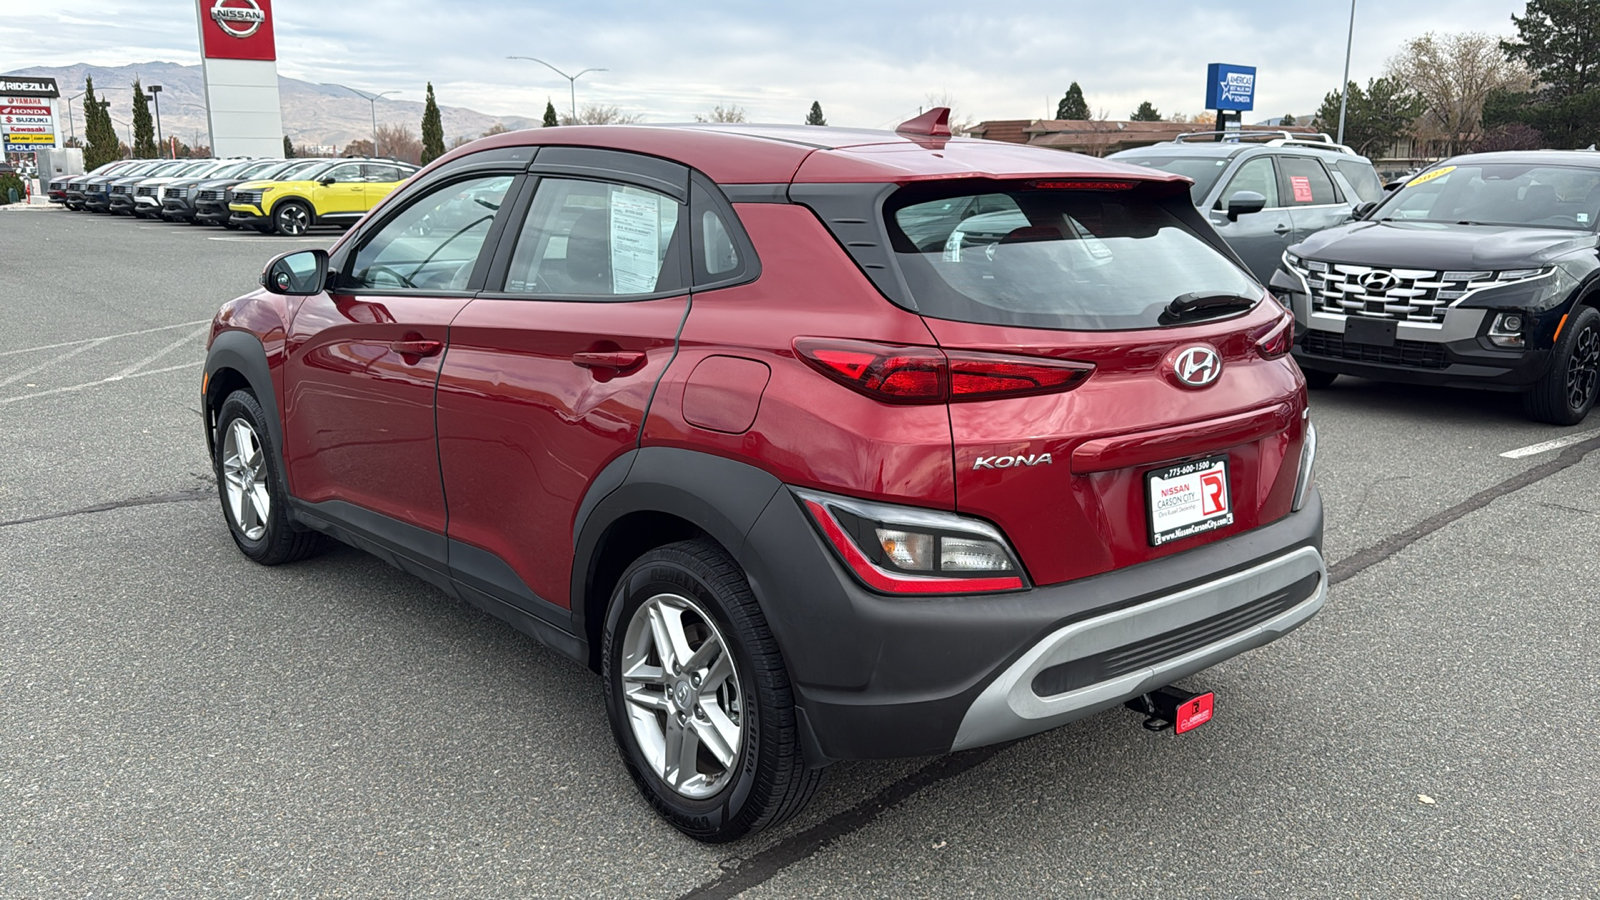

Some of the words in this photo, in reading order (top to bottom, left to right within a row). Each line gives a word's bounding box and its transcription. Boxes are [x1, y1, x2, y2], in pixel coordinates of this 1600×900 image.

[217, 10, 261, 19] NISSAN
[6, 81, 55, 92] RIDEZILLA
[972, 453, 1053, 470] KONA
[1169, 461, 1209, 476] 775-600-1500
[1161, 484, 1190, 497] NISSAN
[1157, 496, 1182, 509] CARSON
[1183, 492, 1195, 502] CITY
[1161, 519, 1227, 541] www.NissanCarsonCity.com
